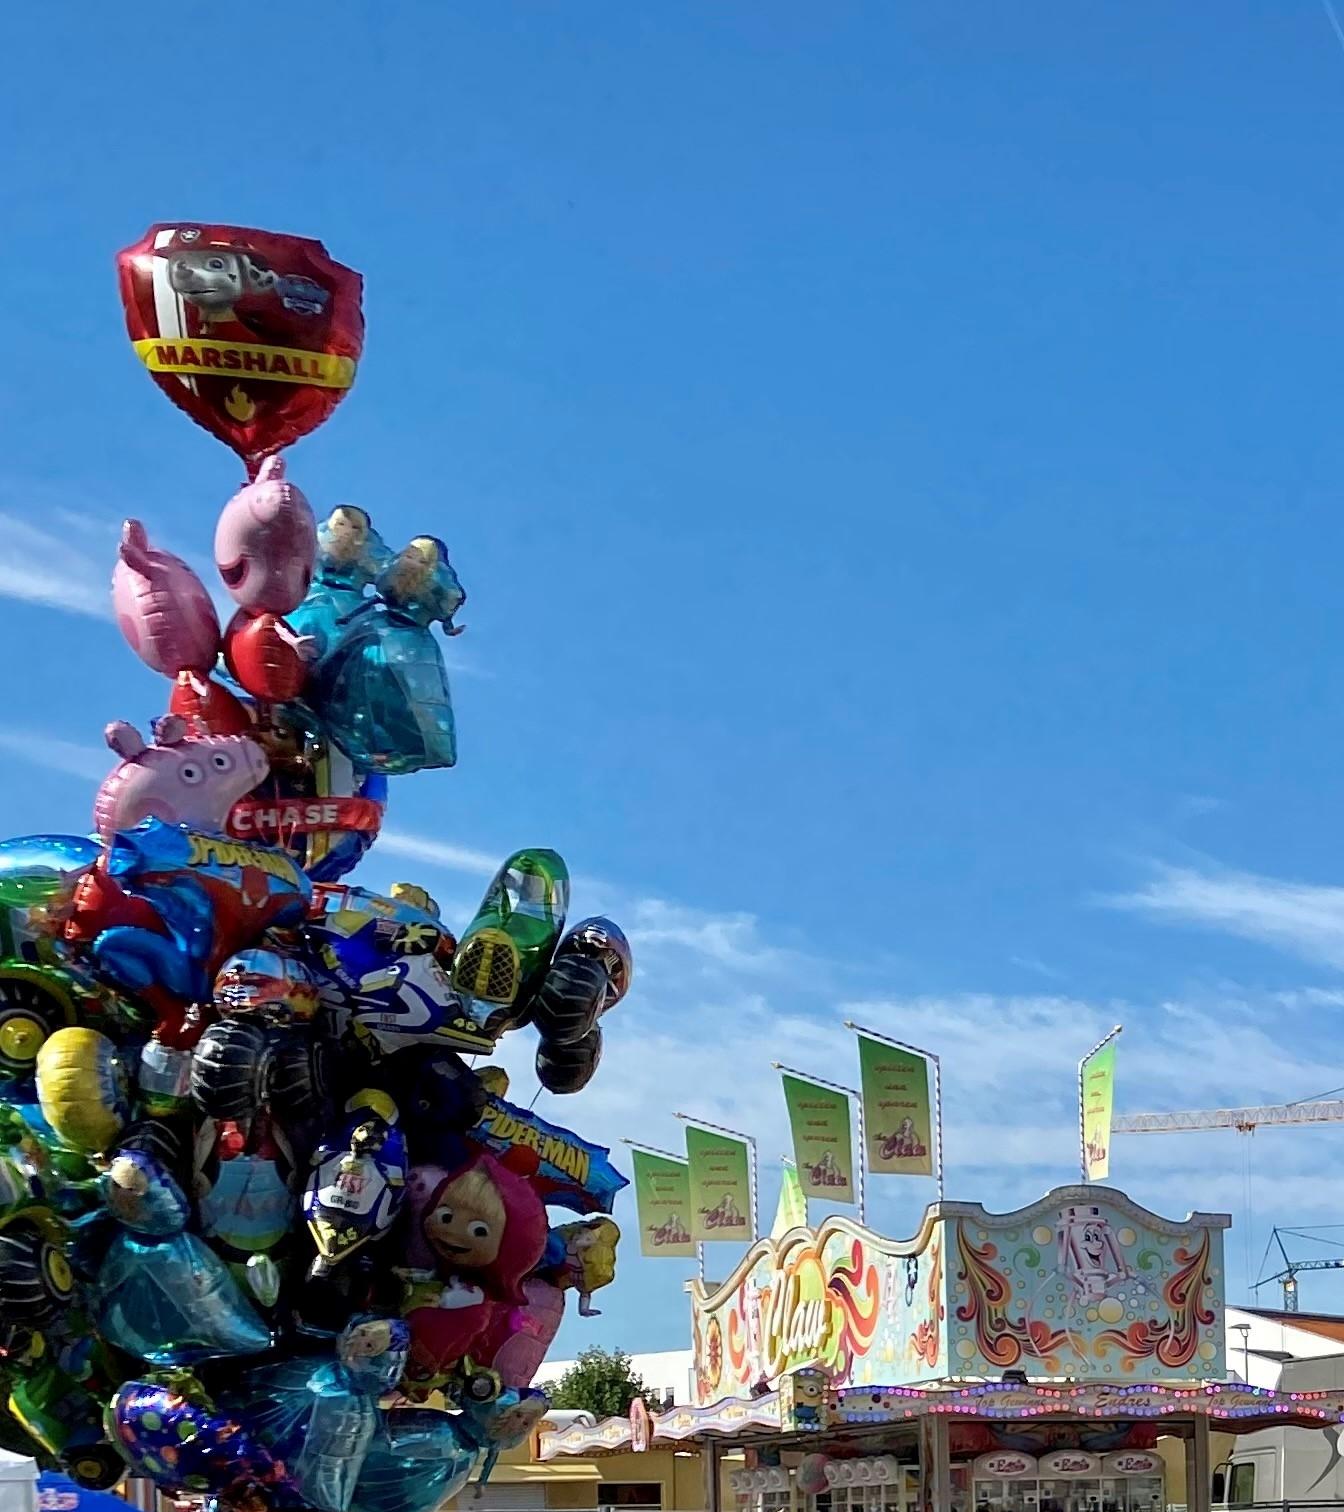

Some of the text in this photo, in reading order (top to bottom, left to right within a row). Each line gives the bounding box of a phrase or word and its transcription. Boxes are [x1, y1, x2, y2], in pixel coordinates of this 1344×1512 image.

[155, 345, 325, 380] MARSHALL
[231, 803, 339, 832] CHASE
[472, 1103, 590, 1185] PIDER-MAN
